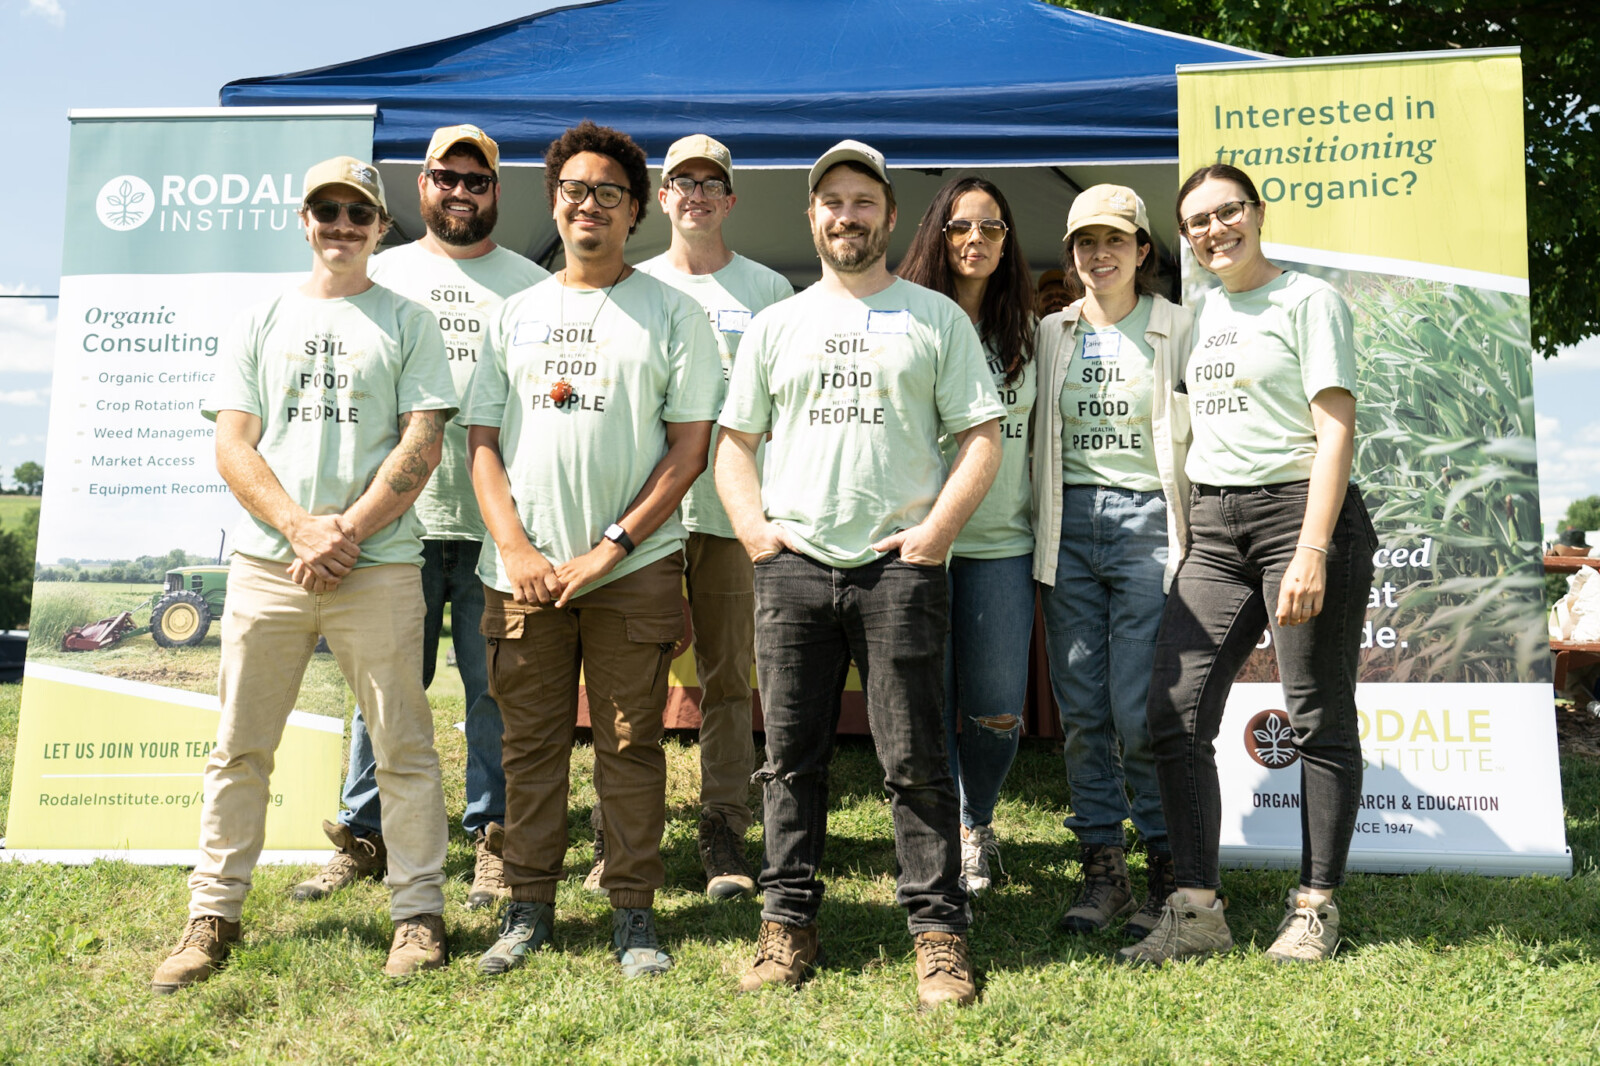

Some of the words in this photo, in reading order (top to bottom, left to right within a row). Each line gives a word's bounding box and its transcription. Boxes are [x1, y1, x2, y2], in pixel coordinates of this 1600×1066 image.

[1214, 96, 1394, 130] Interested
[1405, 95, 1436, 121] in
[1214, 131, 1437, 166] transitioning
[161, 173, 303, 206] RODAL
[1261, 170, 1418, 209] Organic?
[159, 208, 304, 232] INSTITUT
[430, 289, 476, 304] SOIL
[84, 304, 176, 329] Organic
[438, 317, 481, 333] OOD
[551, 328, 597, 344] SOIL
[1204, 331, 1239, 349] SOIL
[82, 333, 219, 357] Consulting
[304, 339, 348, 356] SOIL
[824, 338, 870, 355] SOIL
[445, 346, 478, 363] OPL
[543, 360, 597, 376] FOOD
[1081, 367, 1126, 383] SOIL
[1195, 361, 1235, 383] FOOD
[98, 371, 154, 386] Organic
[158, 370, 216, 383] Certifica
[300, 372, 349, 390] FOOD
[820, 371, 872, 390] FOOD
[96, 399, 130, 413] Crop
[134, 398, 195, 411] Rotation
[287, 404, 359, 424] PEOPLE
[1077, 400, 1129, 417] FOOD
[808, 406, 885, 426] PEOPLE
[93, 427, 133, 439] Weed
[137, 427, 214, 441] Manageme
[1072, 433, 1142, 450] PEOPLE
[91, 455, 143, 467] Market
[146, 455, 196, 466] Access
[88, 482, 167, 497] Equipment
[1356, 708, 1492, 743] DALE
[43, 743, 70, 760] LET
[75, 742, 95, 760] US
[99, 742, 133, 759] JOIN
[139, 741, 180, 759] YOUR
[1252, 792, 1300, 809] ORGAN
[1358, 794, 1396, 810] ARCH
[1401, 794, 1412, 810] &
[1417, 795, 1499, 811] EDUCATION
[1354, 822, 1381, 834] NCE
[1384, 823, 1414, 834] 1947
